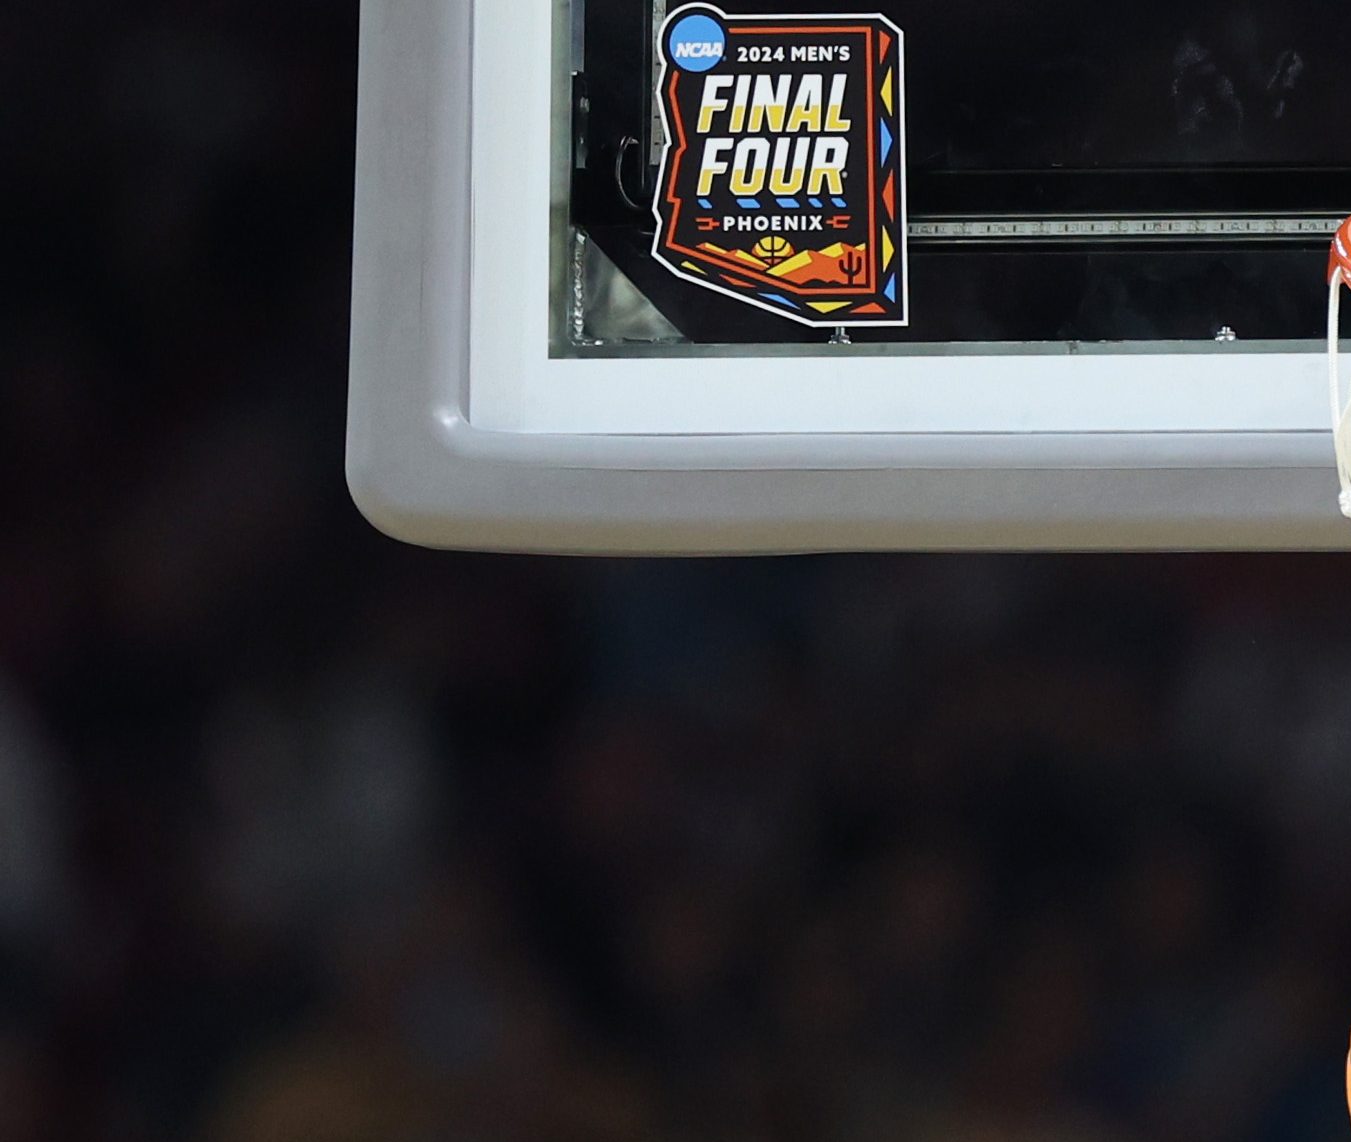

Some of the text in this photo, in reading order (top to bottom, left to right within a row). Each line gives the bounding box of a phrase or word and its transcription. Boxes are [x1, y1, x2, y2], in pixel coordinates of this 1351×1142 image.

[675, 42, 724, 58] NCAA
[737, 46, 850, 62] 2024 MEN'S
[696, 73, 851, 133] FINAL
[696, 136, 849, 196] FOUR
[723, 215, 823, 231] PHOENIX
